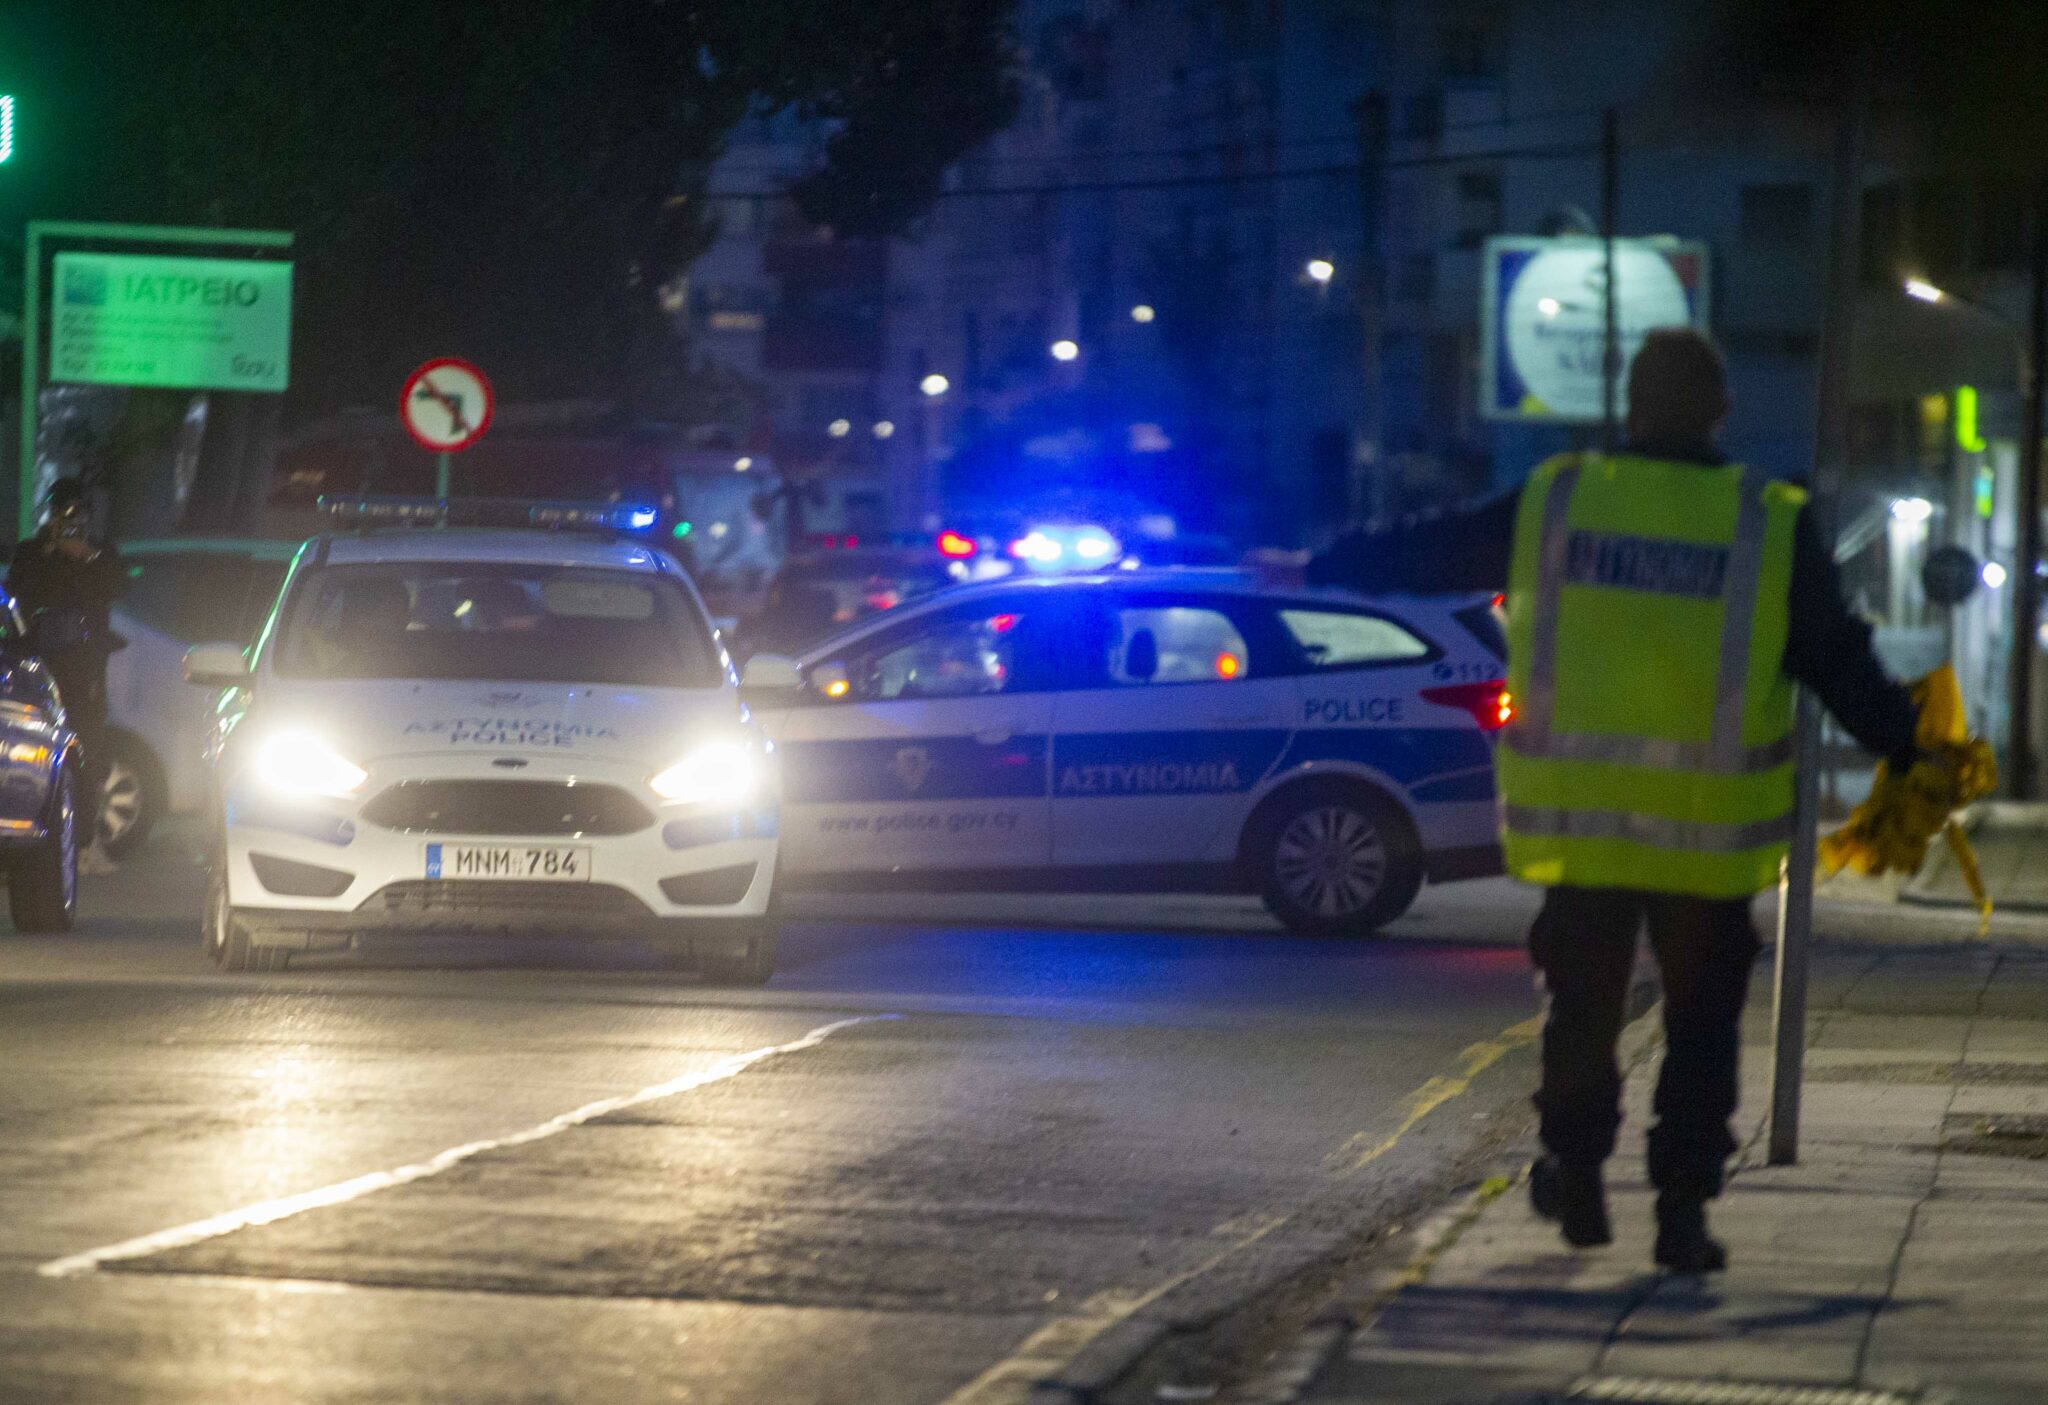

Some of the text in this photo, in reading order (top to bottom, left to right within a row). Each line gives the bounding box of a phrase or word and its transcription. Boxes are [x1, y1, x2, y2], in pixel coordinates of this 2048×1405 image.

[124, 274, 260, 308] ΙΑΤΡΕΙΟ
[1304, 698, 1402, 723] POLICE
[451, 730, 573, 748] POLICE
[1061, 761, 1241, 792] ΑΣΤΥΝΟΜΙΑ
[818, 809, 1020, 834] www.police.gov.cy
[456, 848, 511, 875] MNM
[526, 849, 579, 877] 784
